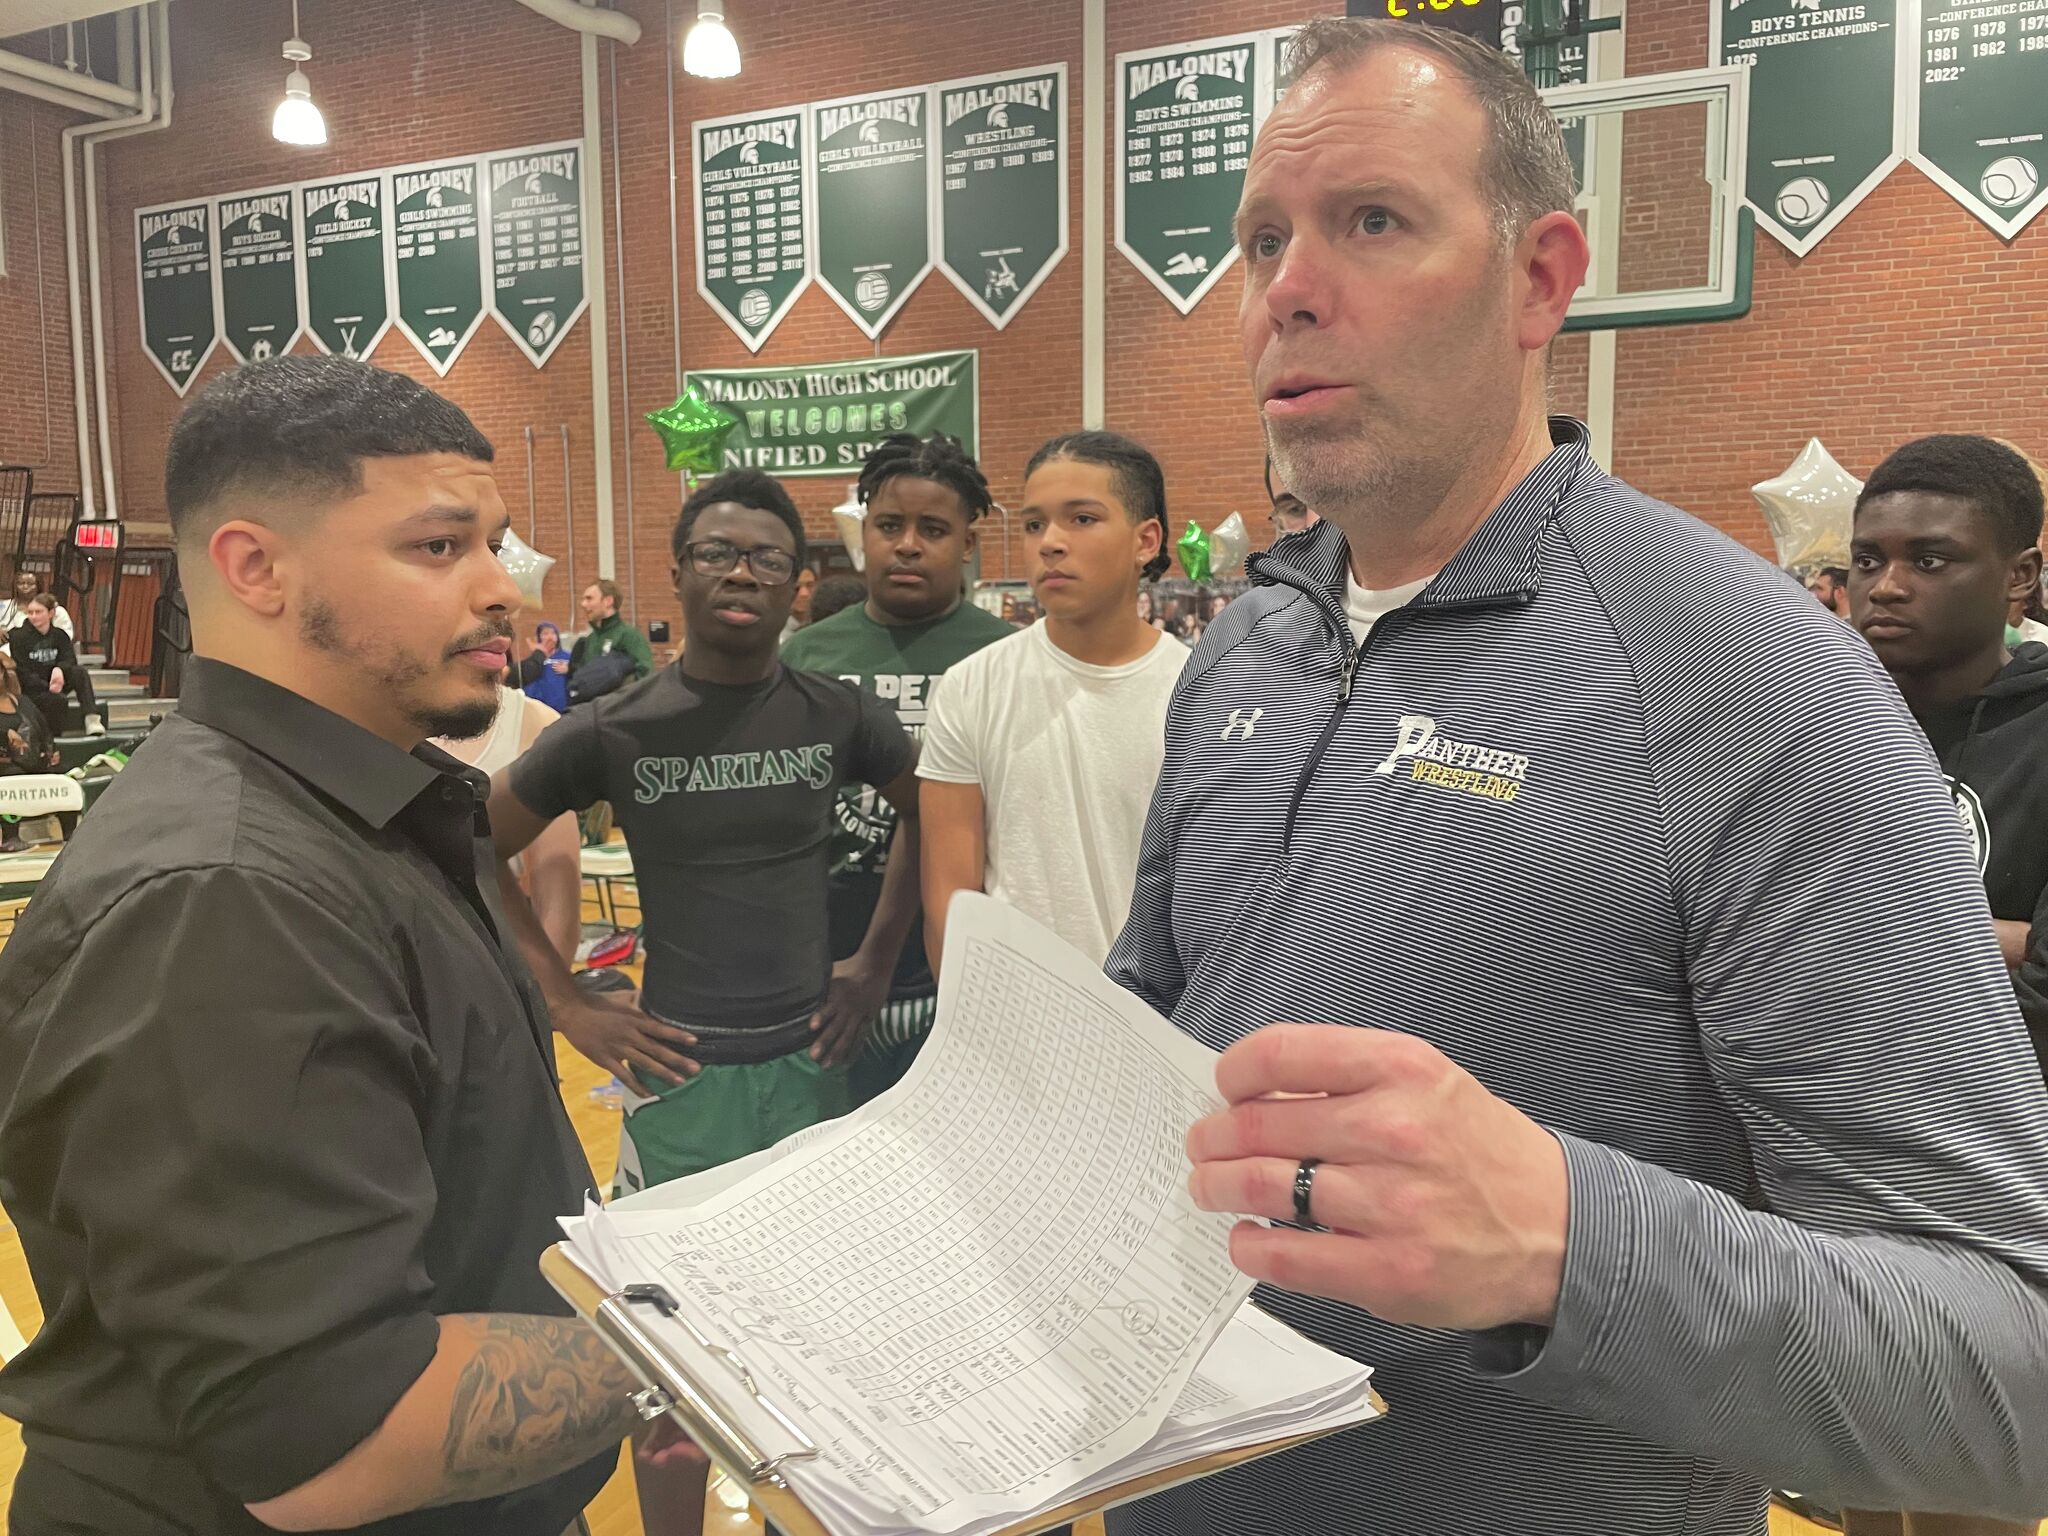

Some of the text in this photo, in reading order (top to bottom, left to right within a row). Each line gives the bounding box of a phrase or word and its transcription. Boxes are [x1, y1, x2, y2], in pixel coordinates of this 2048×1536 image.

[1751, 6, 1865, 33] BOYS TENNIS
[1940, 3, 2017, 23] CONFERENCE
[1738, 22, 1878, 50] CONFERENCE CHAMPIONS
[1927, 27, 1960, 43] 1976
[1973, 21, 2006, 38] 1978
[1727, 53, 1758, 66] 1976
[1927, 46, 1958, 63] 1981
[1973, 40, 2006, 58] 1982
[1129, 49, 1249, 100] MALONEY
[821, 96, 921, 142] MALONEY
[946, 79, 1053, 127] MALONEY
[1136, 107, 1169, 122] BOYS
[703, 119, 797, 163] MALONEY
[965, 125, 1035, 145] WRESTLING
[396, 167, 473, 206] MALONEY
[492, 152, 576, 192] MALONEY
[221, 195, 289, 230] MALONEY
[306, 181, 378, 218] MALONEY
[512, 192, 559, 208] FOOTBALL
[142, 208, 206, 242] MALONEY
[702, 366, 957, 402] MALONEY HIGH SCHOOL
[746, 401, 908, 438] WELCOMES
[724, 444, 827, 468] NIFIED
[1375, 714, 1529, 780] PANTHER
[634, 744, 833, 804] SPARTANS
[1411, 759, 1520, 801] WRESTLING
[0, 786, 69, 800] PARTANS
[835, 800, 890, 844] ALONEY
